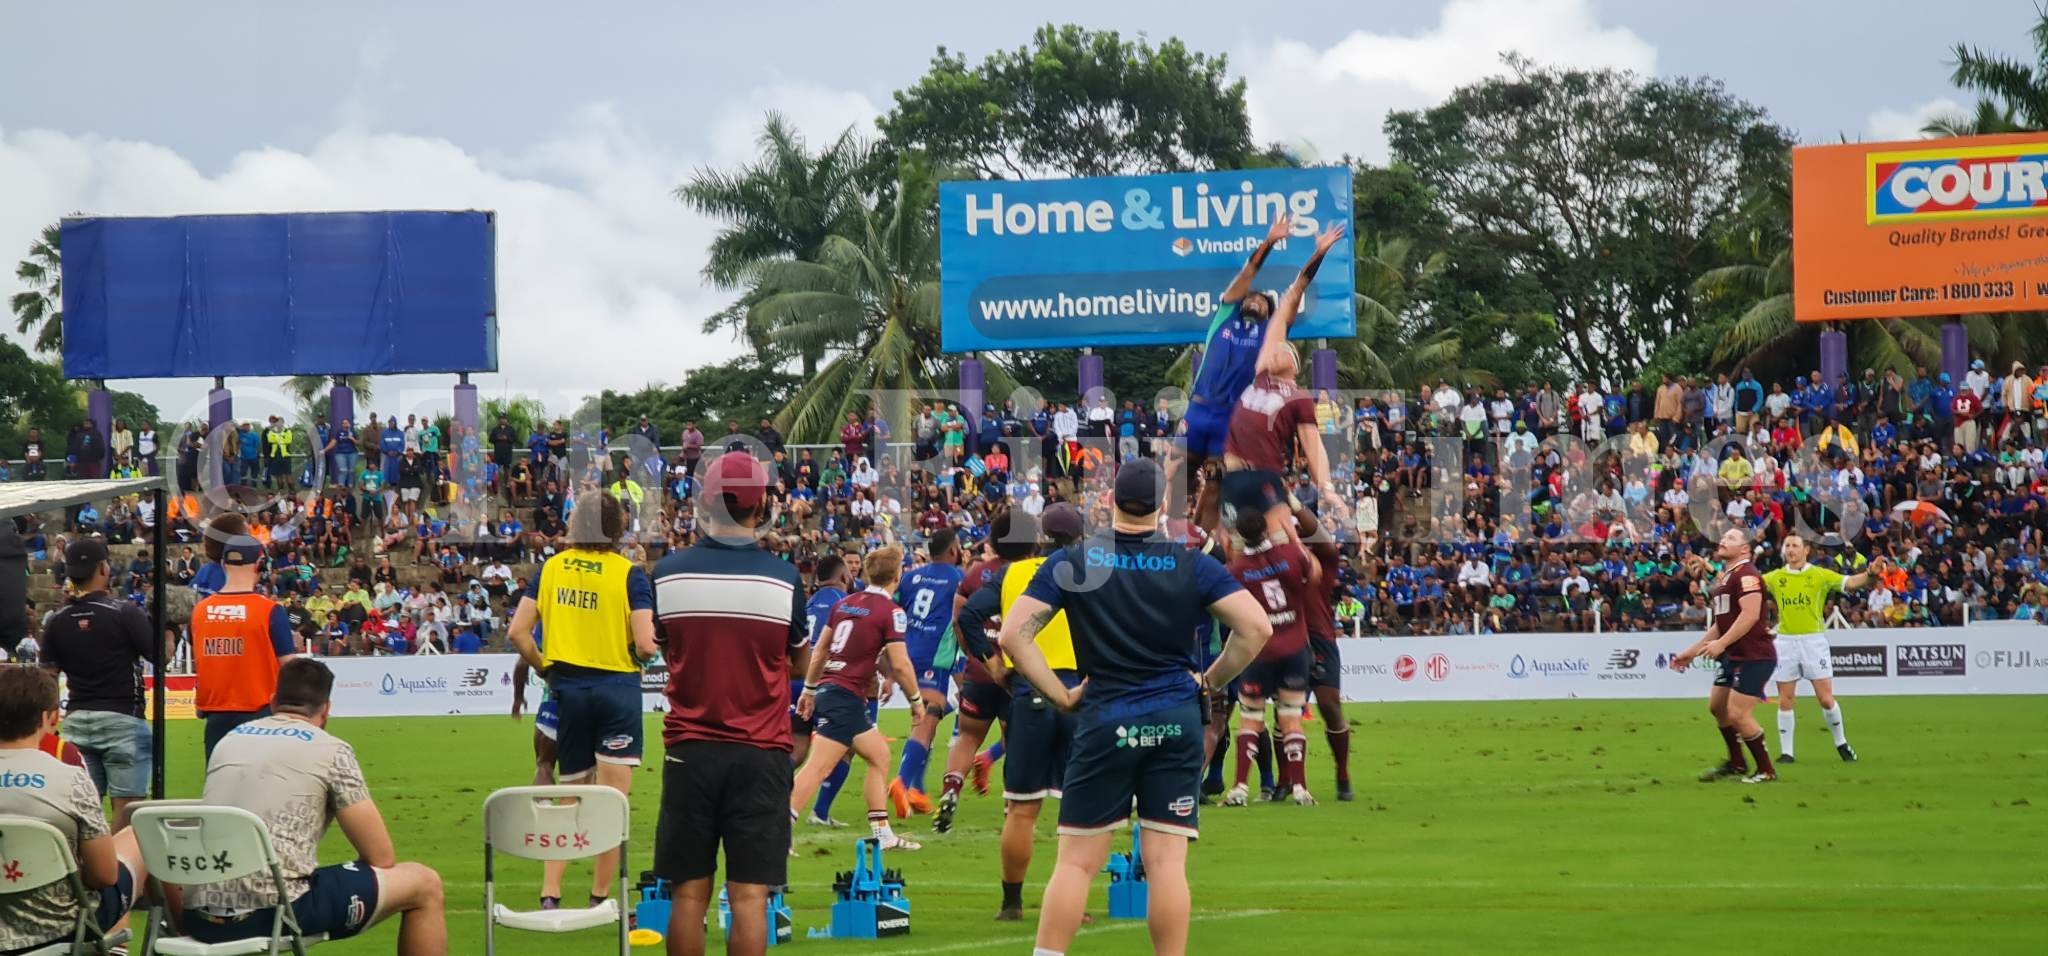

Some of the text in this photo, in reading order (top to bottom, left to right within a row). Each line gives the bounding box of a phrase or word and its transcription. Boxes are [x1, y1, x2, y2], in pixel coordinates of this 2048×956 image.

[965, 180, 1319, 238] Home & Living
[1197, 235, 1287, 254] Vinod Pael
[1889, 228, 1946, 247] Quality
[1950, 225, 2010, 243] Brands!
[1823, 288, 1896, 306] Customer
[1900, 286, 1938, 302] Care:
[1984, 280, 2015, 298] 333
[1086, 546, 1176, 571] Santos
[557, 587, 598, 610] WATER
[912, 588, 935, 619] 8
[830, 619, 854, 654] 9
[204, 638, 244, 656] MEDIC
[1898, 646, 1964, 660] RATSUN
[1426, 656, 1448, 680] MG
[1529, 657, 1590, 678] AquaSafe
[1831, 653, 1883, 665] nod Patel
[1926, 659, 1953, 667] AIRPORT
[1994, 651, 2031, 668] FIJI
[1341, 663, 1387, 675] SHIPPING
[397, 676, 448, 692] AquaSafe
[1140, 724, 1182, 736] CROSS
[1140, 735, 1164, 747] BET
[0, 769, 46, 789] tos
[525, 833, 567, 848] FSC
[167, 855, 208, 871] FSC
